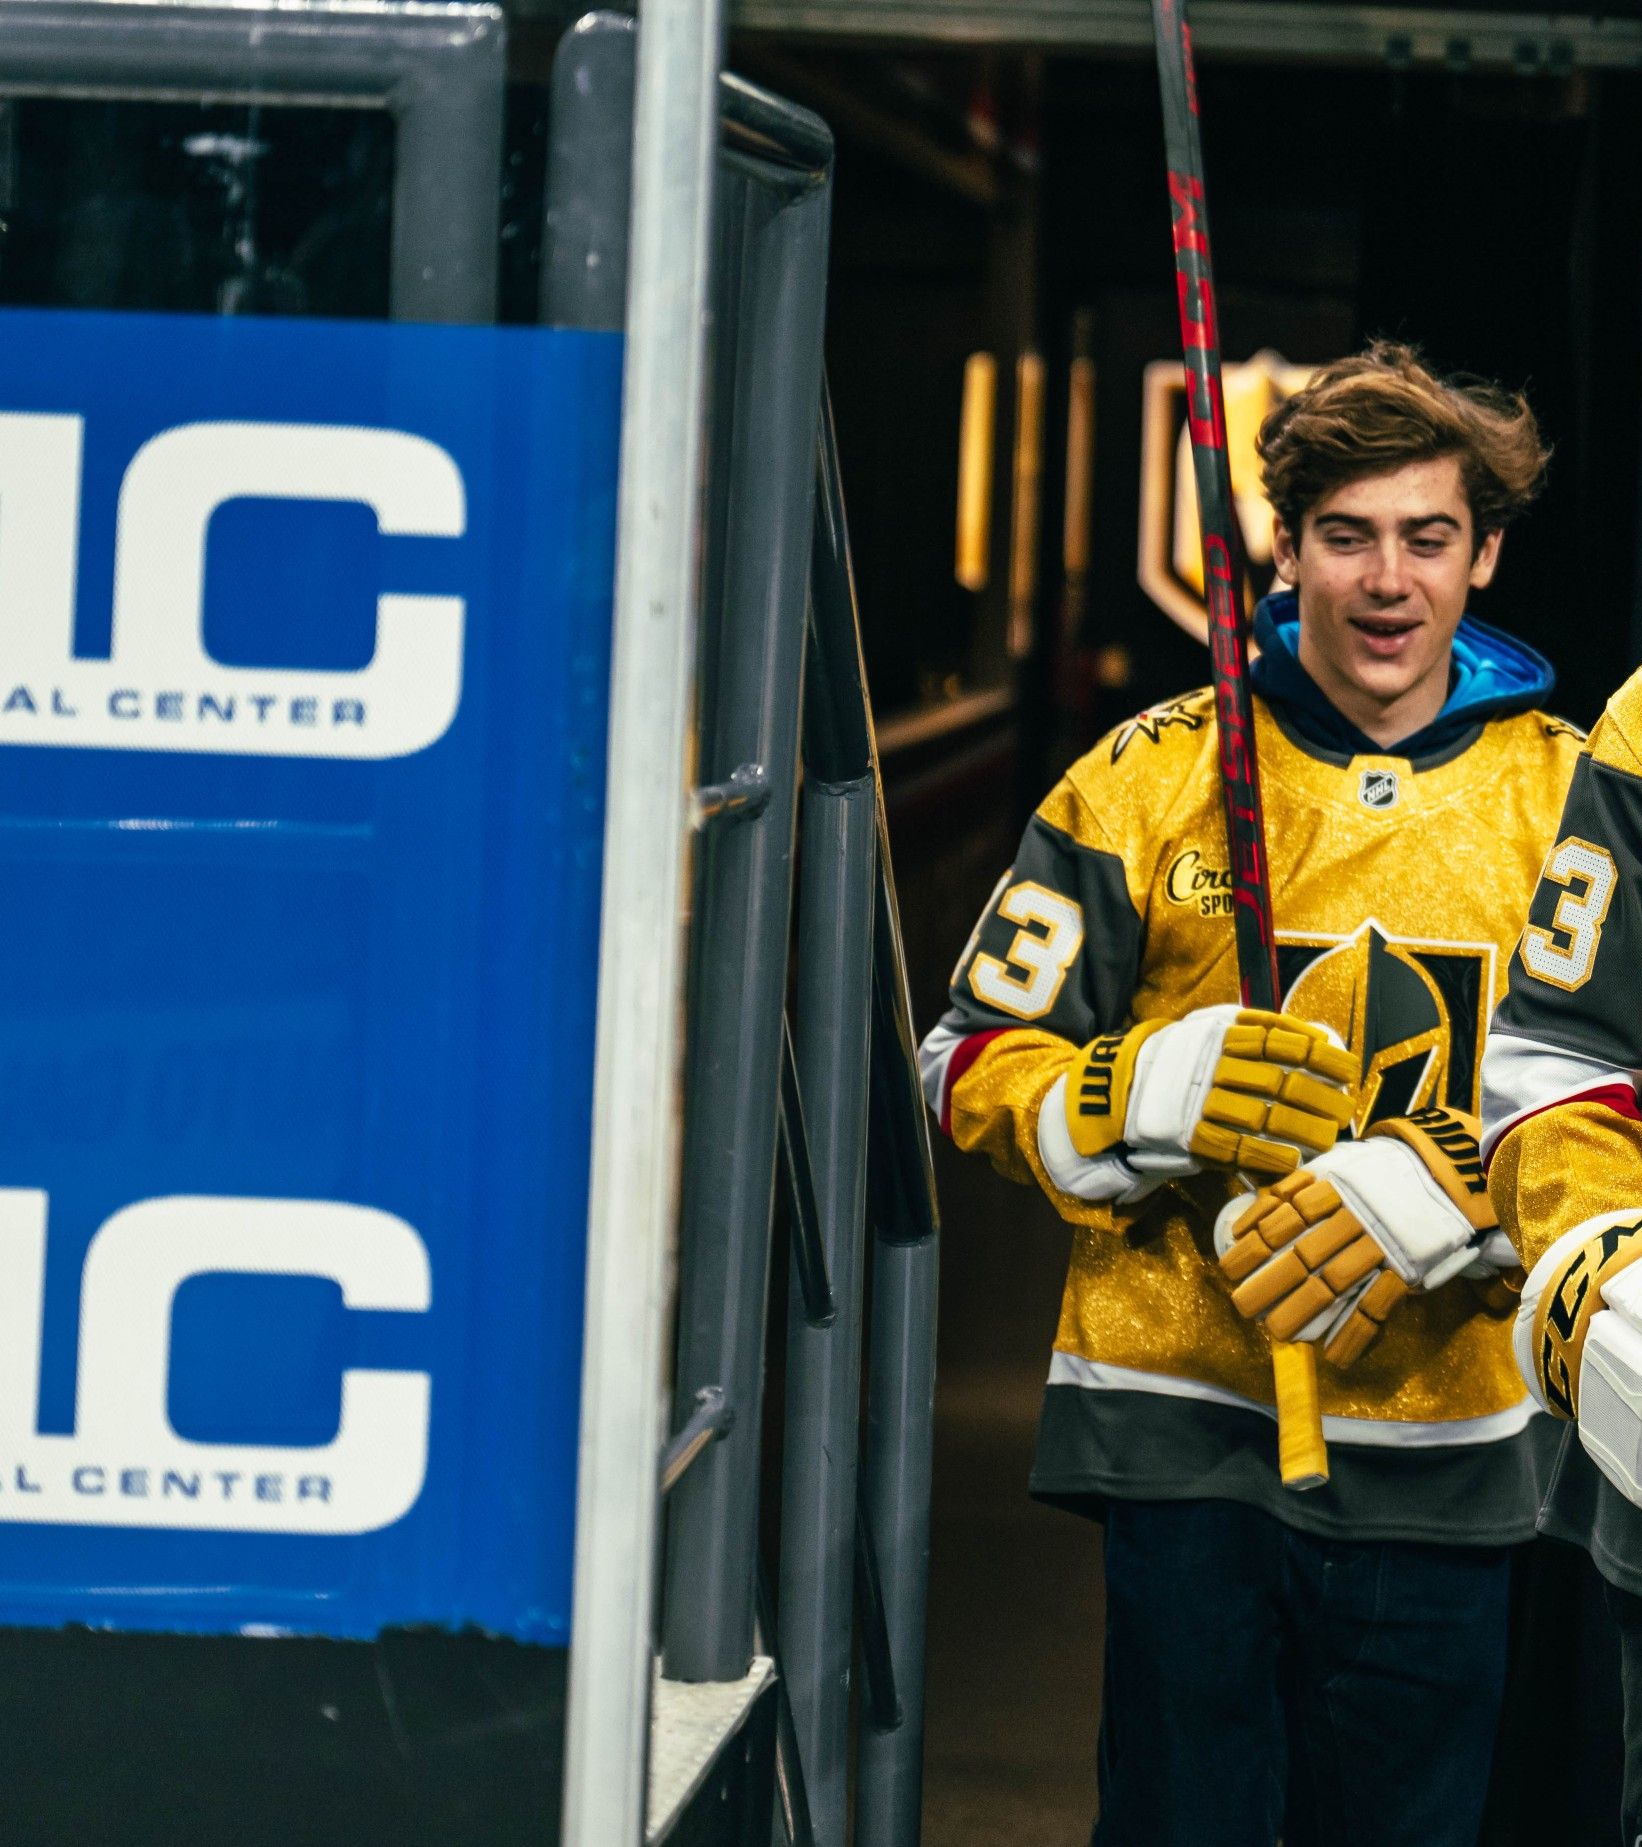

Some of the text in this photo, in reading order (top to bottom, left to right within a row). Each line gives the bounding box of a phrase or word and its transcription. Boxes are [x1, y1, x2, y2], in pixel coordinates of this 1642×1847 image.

[1167, 169, 1225, 450] CCM
[0, 411, 466, 760] C
[105, 688, 368, 729] CENTER
[950, 869, 1087, 1022] 3
[71, 1466, 335, 1504] CENTER
